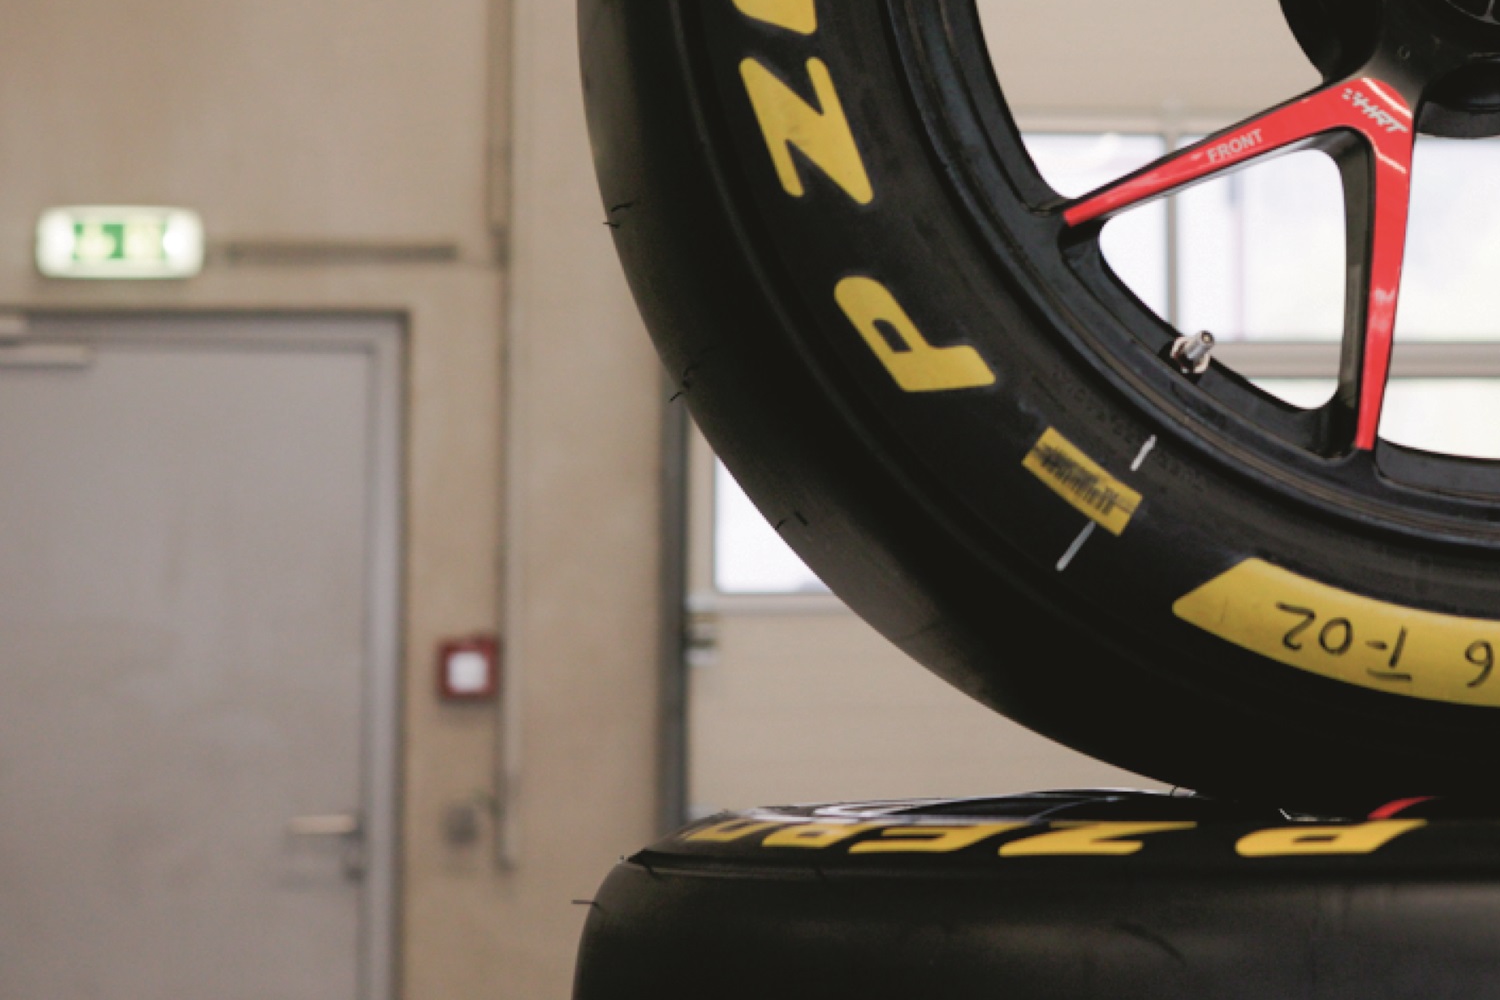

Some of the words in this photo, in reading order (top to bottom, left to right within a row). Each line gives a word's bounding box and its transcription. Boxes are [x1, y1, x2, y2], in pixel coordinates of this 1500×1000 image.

[1206, 128, 1263, 164] FRONT
[834, 276, 996, 392] P
[1234, 818, 1428, 858] P
